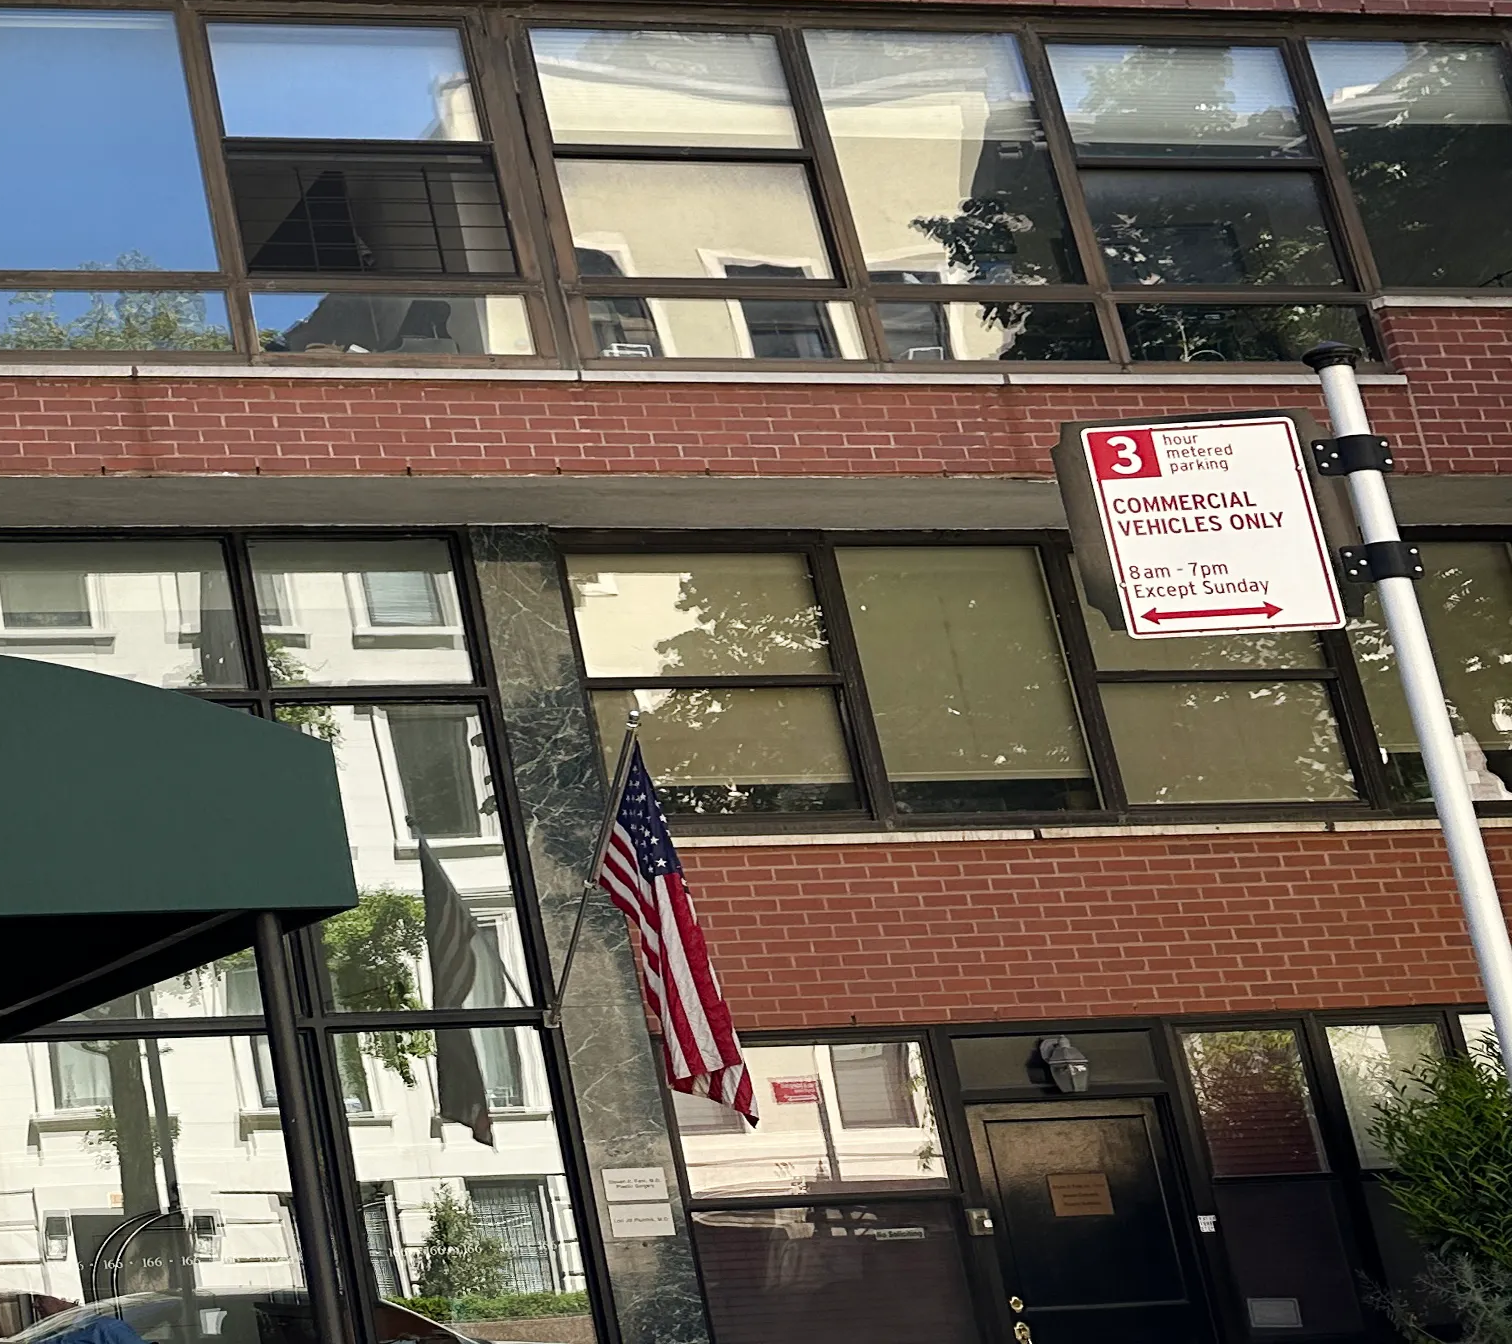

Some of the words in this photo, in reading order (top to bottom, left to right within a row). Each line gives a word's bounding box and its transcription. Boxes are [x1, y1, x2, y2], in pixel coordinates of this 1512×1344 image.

[1162, 433, 1199, 446] hour
[1106, 435, 1143, 475] 3
[1166, 443, 1233, 459] metered
[1170, 457, 1230, 474] parking
[1112, 490, 1257, 515] COMMERCIAL
[1116, 515, 1223, 537] VEHICLES
[1229, 511, 1284, 531] ONLY
[1187, 562, 1229, 580] 7pm
[1134, 581, 1196, 600] Except
[1203, 578, 1270, 596] Sunday
[103, 1258, 124, 1270] 166
[142, 1256, 163, 1268] 166
[181, 1255, 201, 1266] 166
